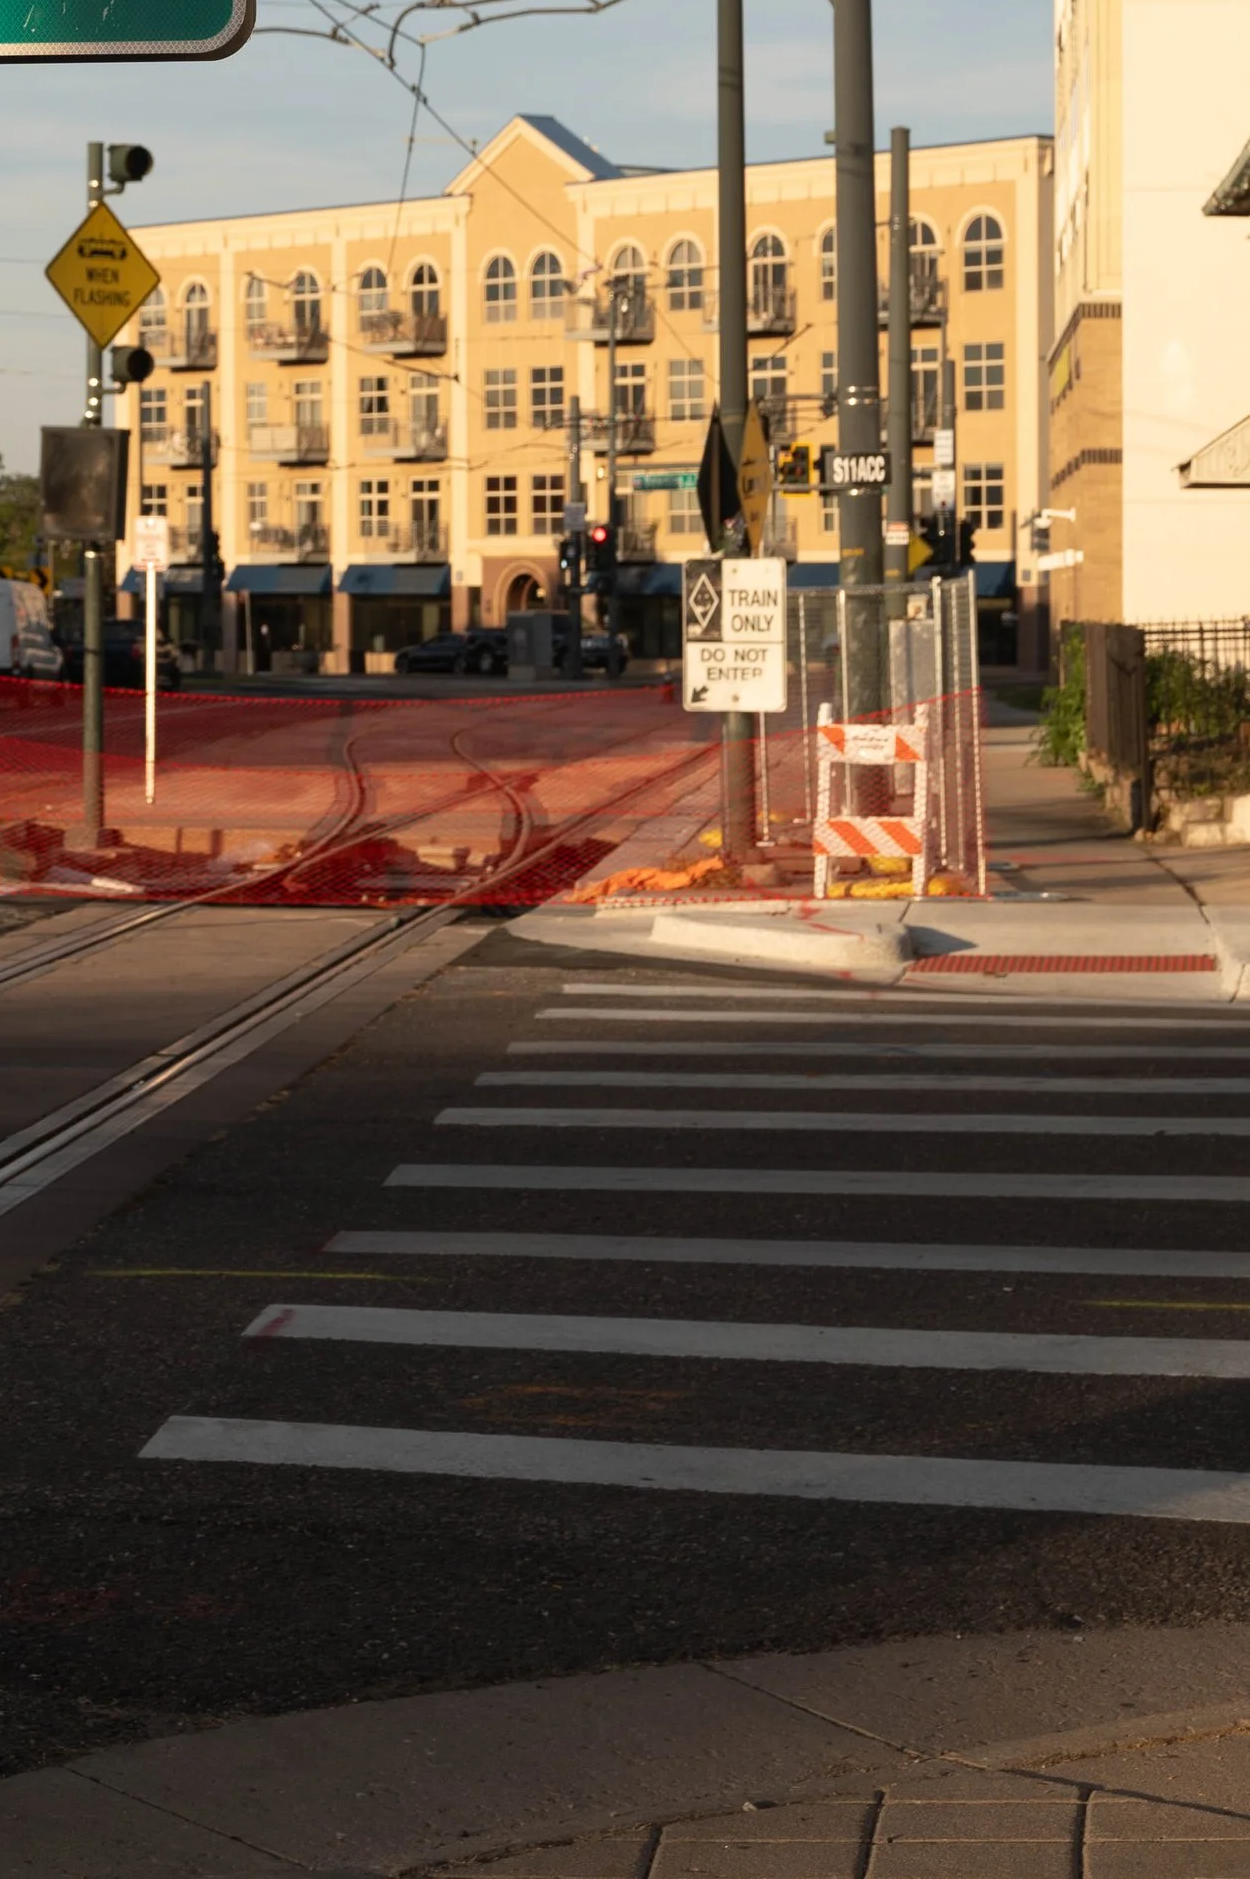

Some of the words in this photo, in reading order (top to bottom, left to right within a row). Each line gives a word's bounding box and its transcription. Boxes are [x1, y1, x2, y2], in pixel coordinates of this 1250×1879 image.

[73, 287, 131, 307] FLASHING
[833, 455, 886, 484] S11ACC
[728, 589, 778, 607] TRAIN
[731, 614, 774, 632] ONLY
[700, 648, 725, 663] DO
[734, 648, 768, 663] NOT
